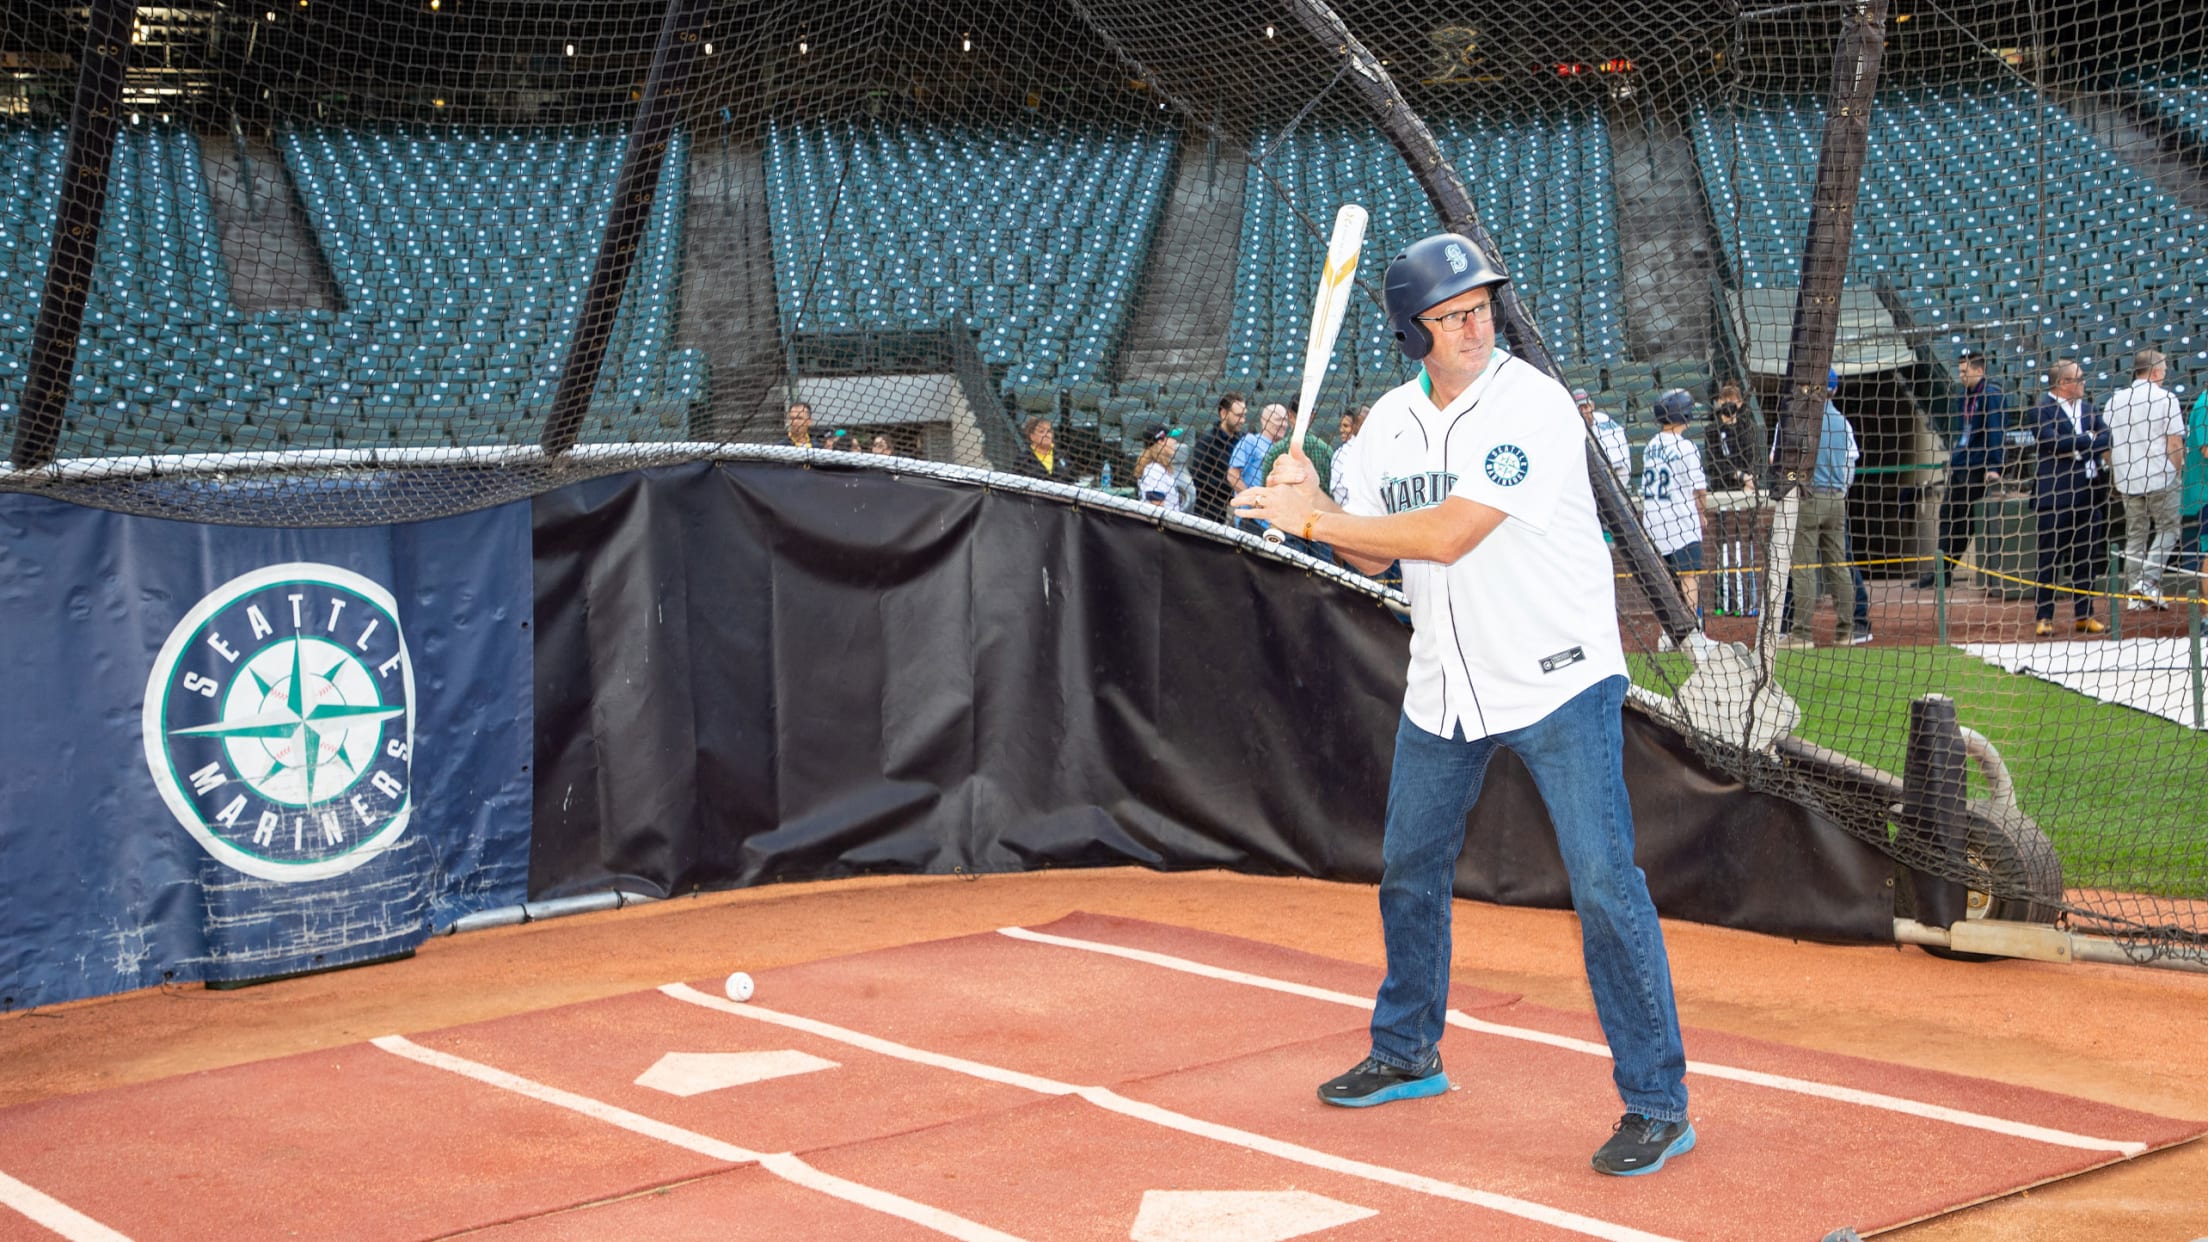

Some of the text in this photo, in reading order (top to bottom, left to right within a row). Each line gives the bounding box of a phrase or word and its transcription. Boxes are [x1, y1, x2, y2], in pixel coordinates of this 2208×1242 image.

[1644, 467, 1671, 500] 22
[183, 593, 403, 698] SEATTLE
[189, 738, 409, 851] MARINERS
